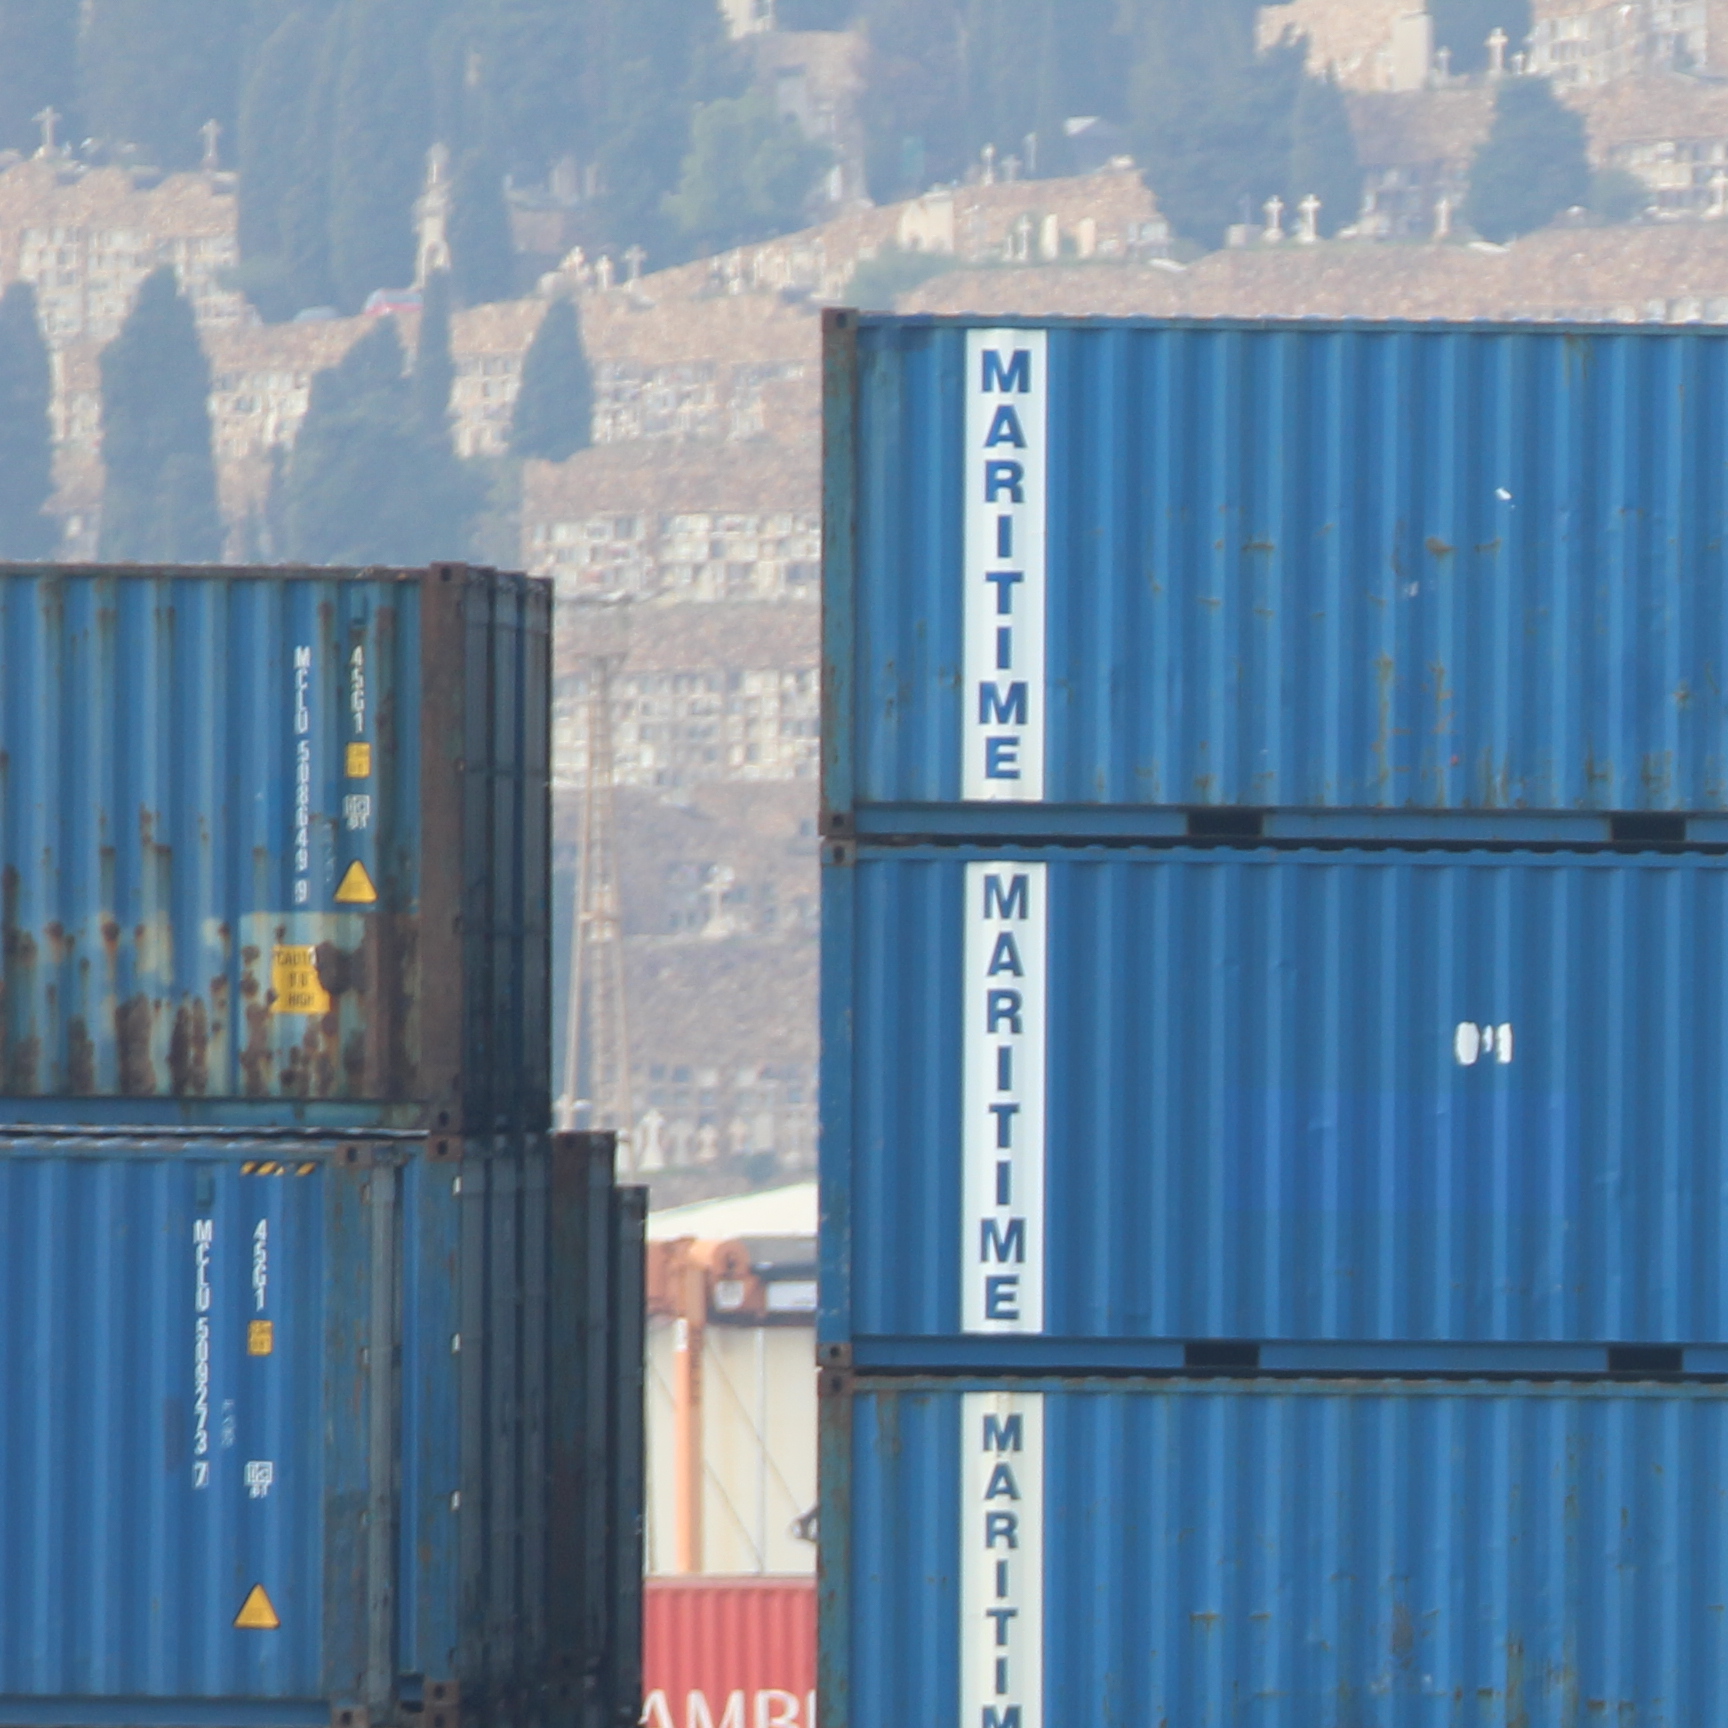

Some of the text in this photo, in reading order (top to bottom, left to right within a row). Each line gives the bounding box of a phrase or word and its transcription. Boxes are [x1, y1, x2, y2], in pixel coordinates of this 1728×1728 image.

[353, 647, 366, 733] 45G1
[978, 349, 1032, 781] MARITIME
[296, 648, 312, 899] MCLU 508649 9
[980, 873, 1030, 1322] MARITIME
[195, 1221, 214, 1488] MCLU 509273 7
[254, 1220, 269, 1311] 45G1
